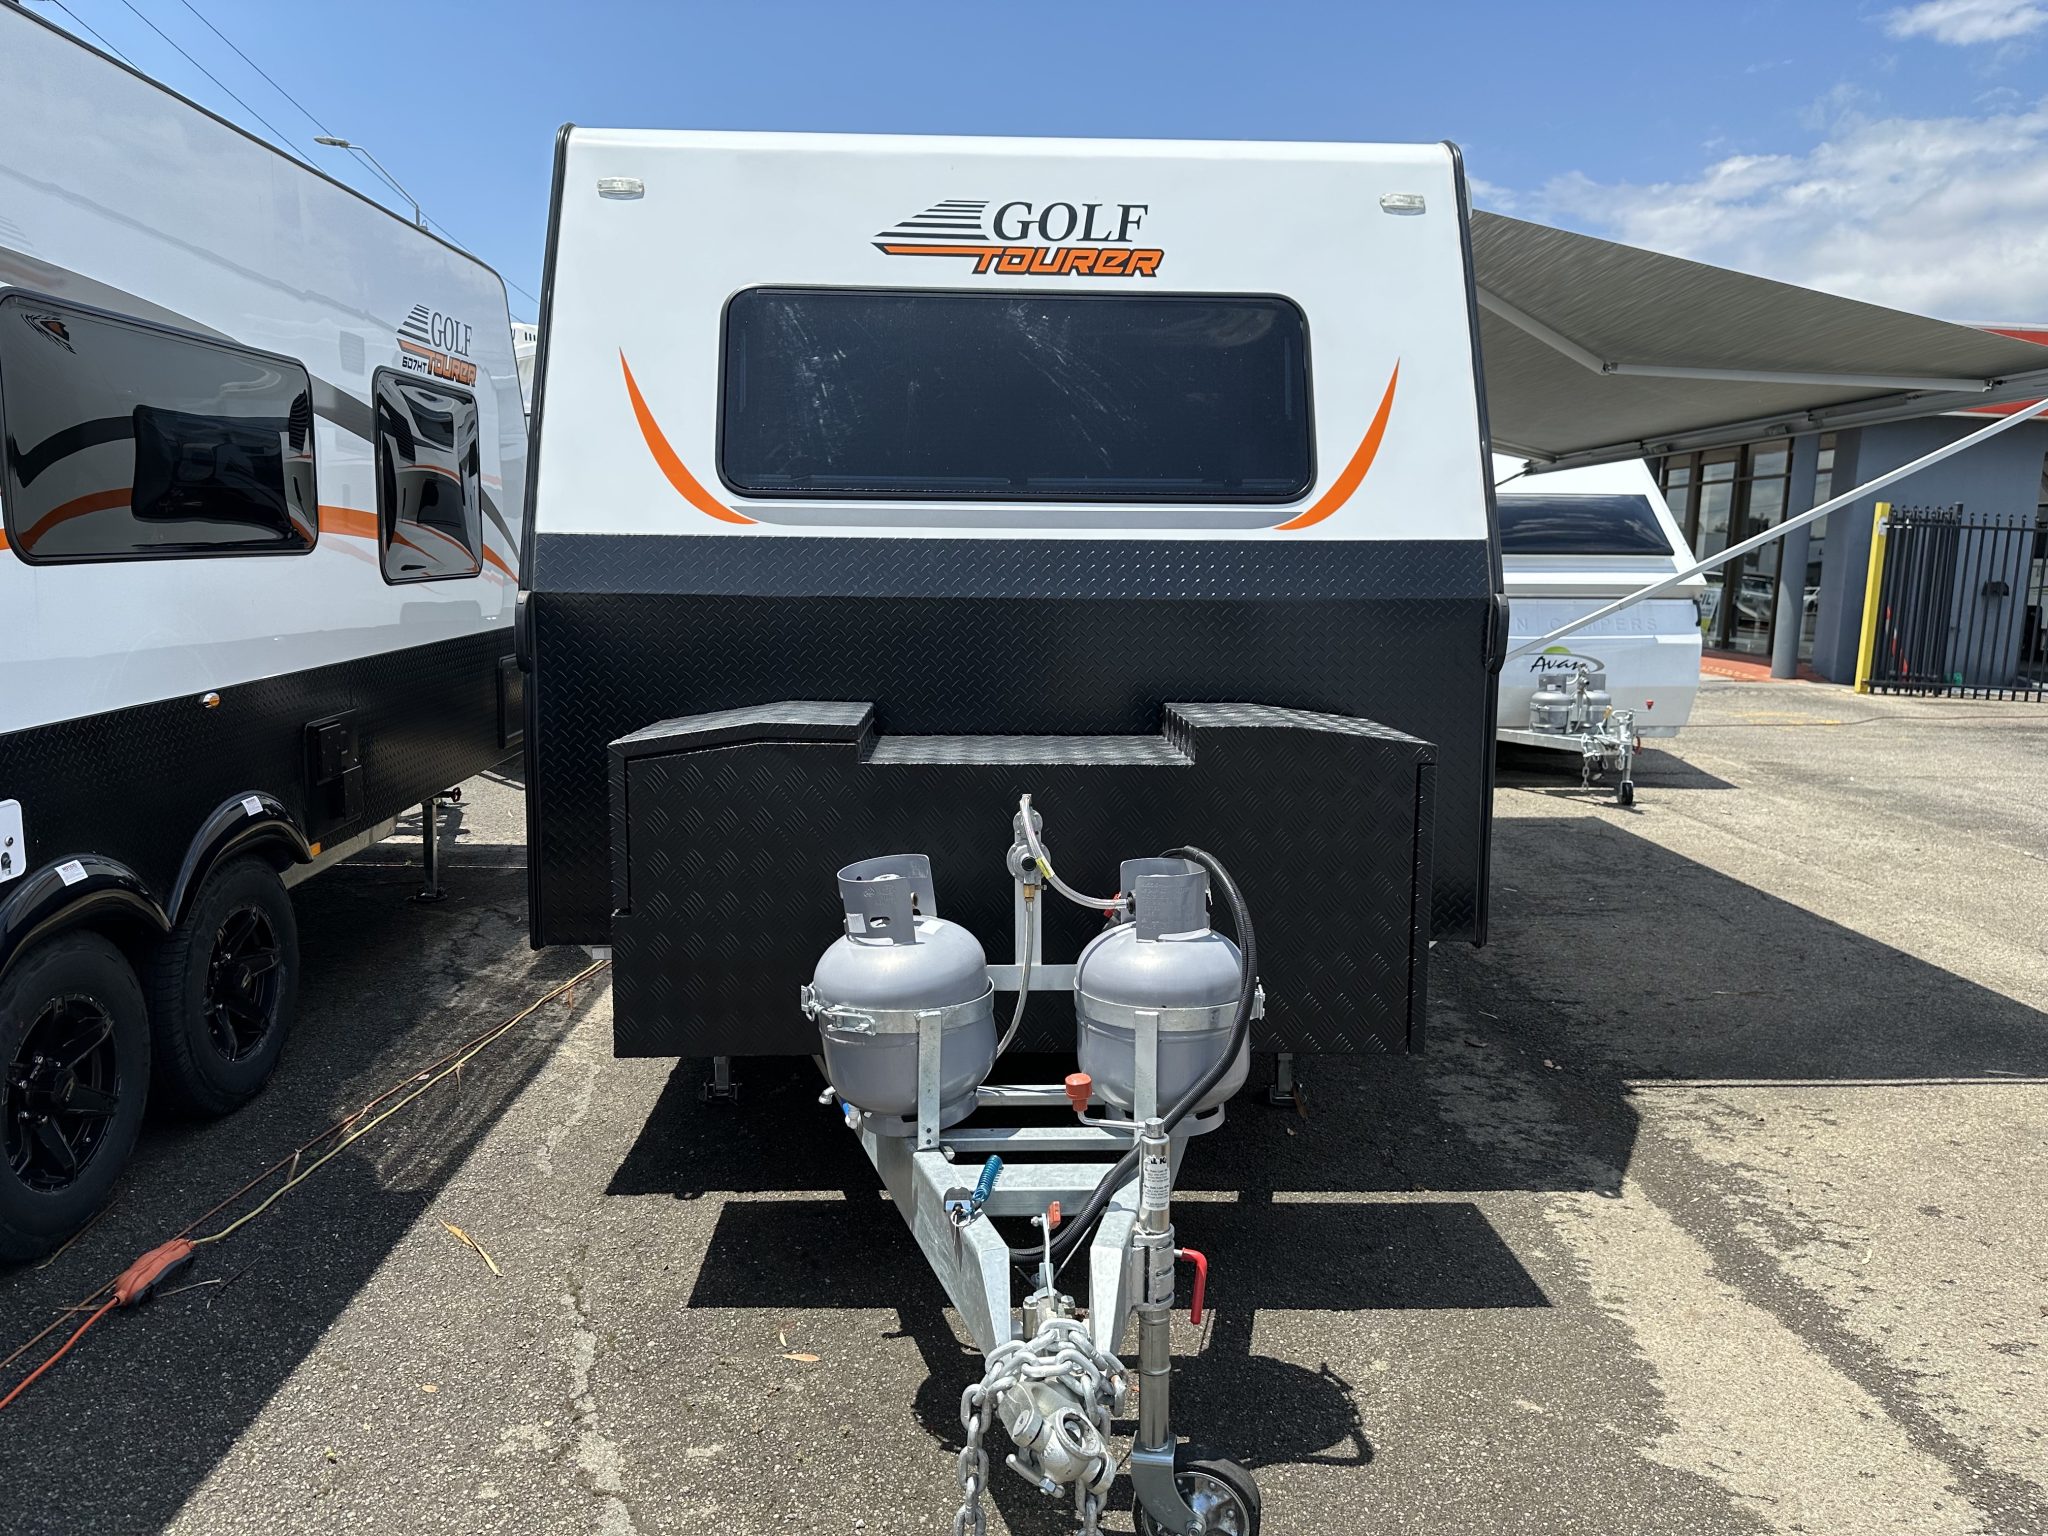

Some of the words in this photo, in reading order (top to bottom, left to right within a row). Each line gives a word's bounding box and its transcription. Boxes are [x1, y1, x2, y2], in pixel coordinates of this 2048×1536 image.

[993, 201, 1149, 242] GOLF
[972, 246, 1165, 277] TOURER
[431, 312, 472, 357] GOLF
[425, 351, 477, 387] TOURER
